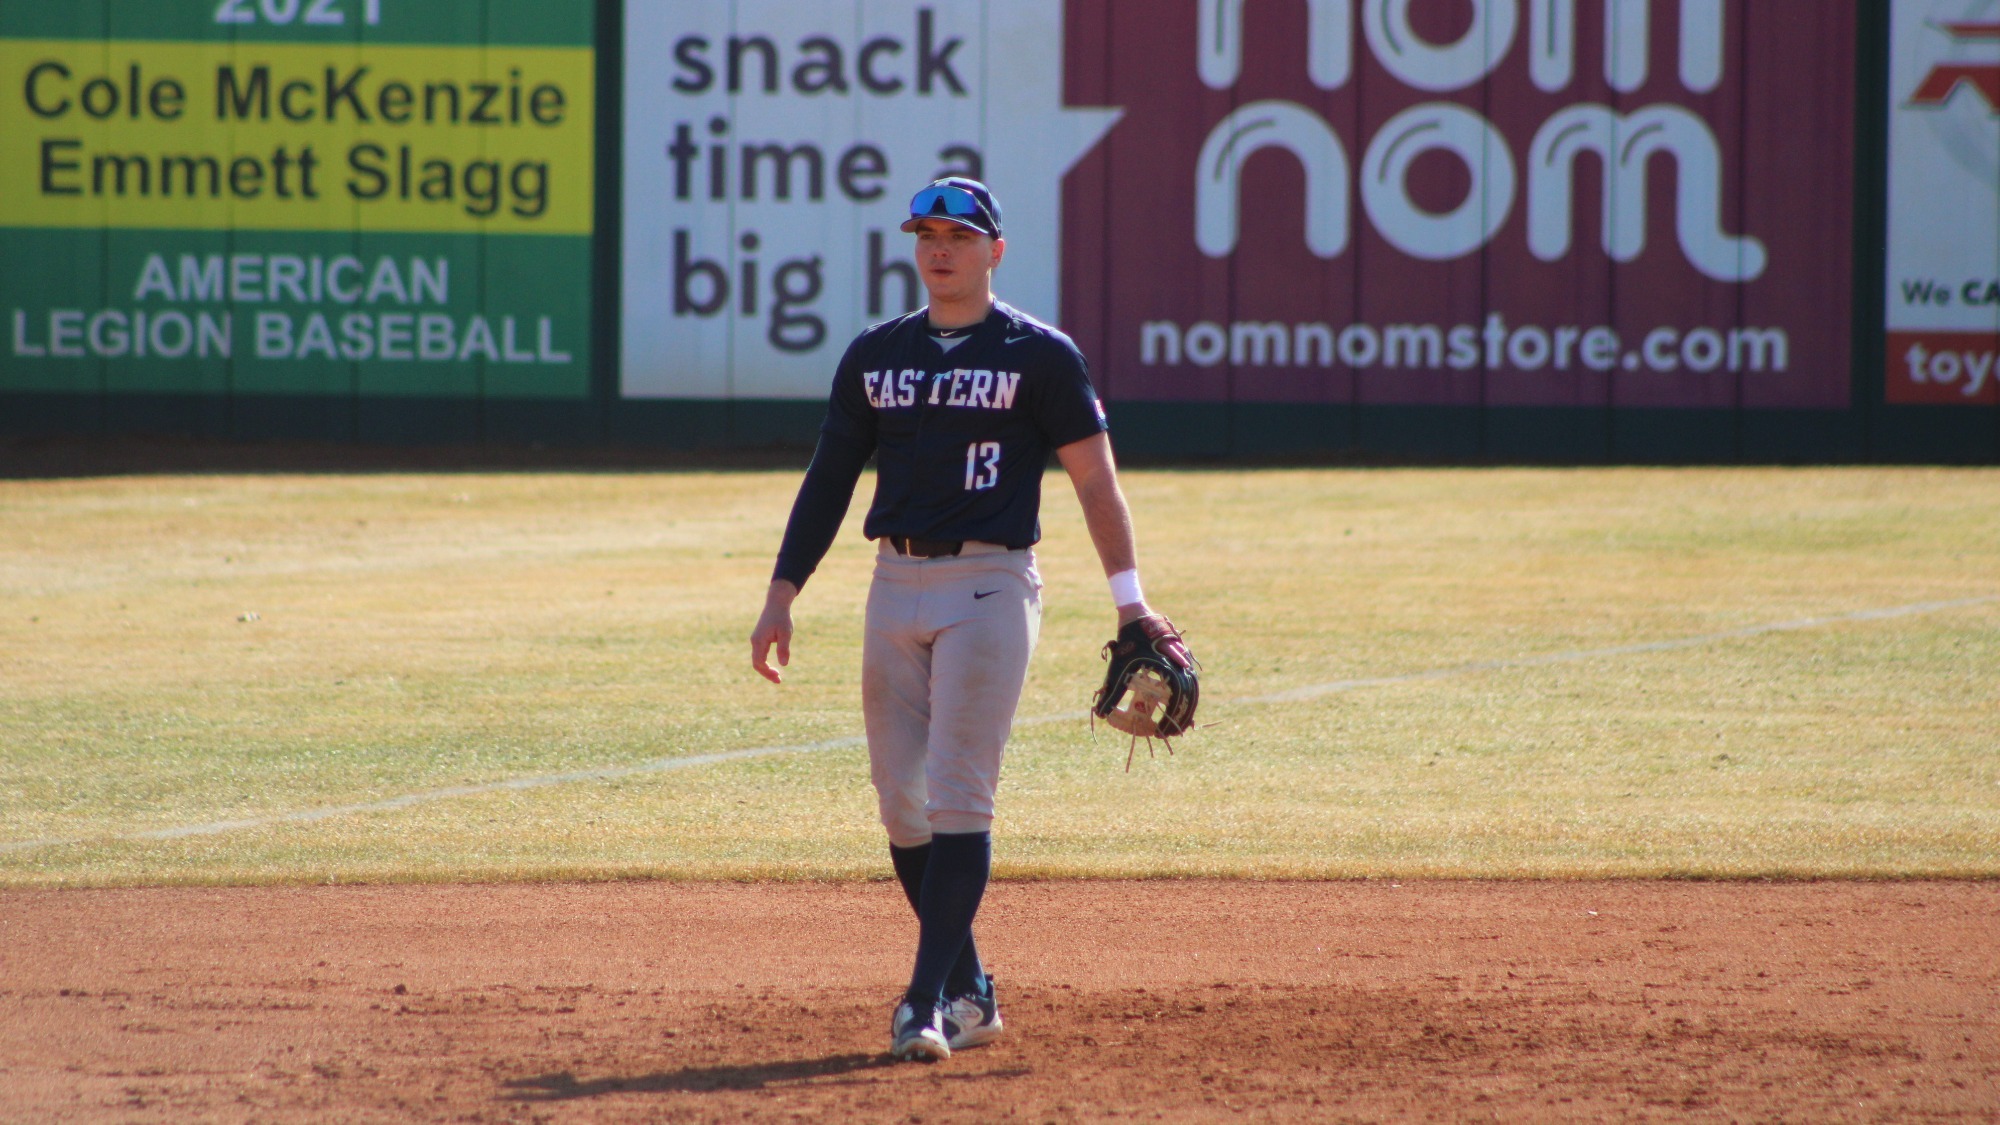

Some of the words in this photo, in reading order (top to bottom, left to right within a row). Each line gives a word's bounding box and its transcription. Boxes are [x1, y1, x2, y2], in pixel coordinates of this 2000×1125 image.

[671, 8, 966, 95] snack
[23, 61, 186, 120] Cole
[215, 64, 566, 126] McKenzie
[40, 139, 318, 199] Emmett
[346, 144, 549, 218] Slagg
[667, 116, 889, 202] time
[1195, 100, 1766, 281] nom
[134, 254, 448, 304] AMERICAN
[672, 229, 828, 354] big
[1901, 280, 1951, 306] We
[13, 310, 232, 358] LEGION
[256, 313, 572, 363] BASEBALL
[1140, 313, 1788, 371] nomnomstore.com
[863, 368, 1021, 410] EASTERN
[1905, 342, 2000, 396] toy
[964, 441, 1001, 491] 13
